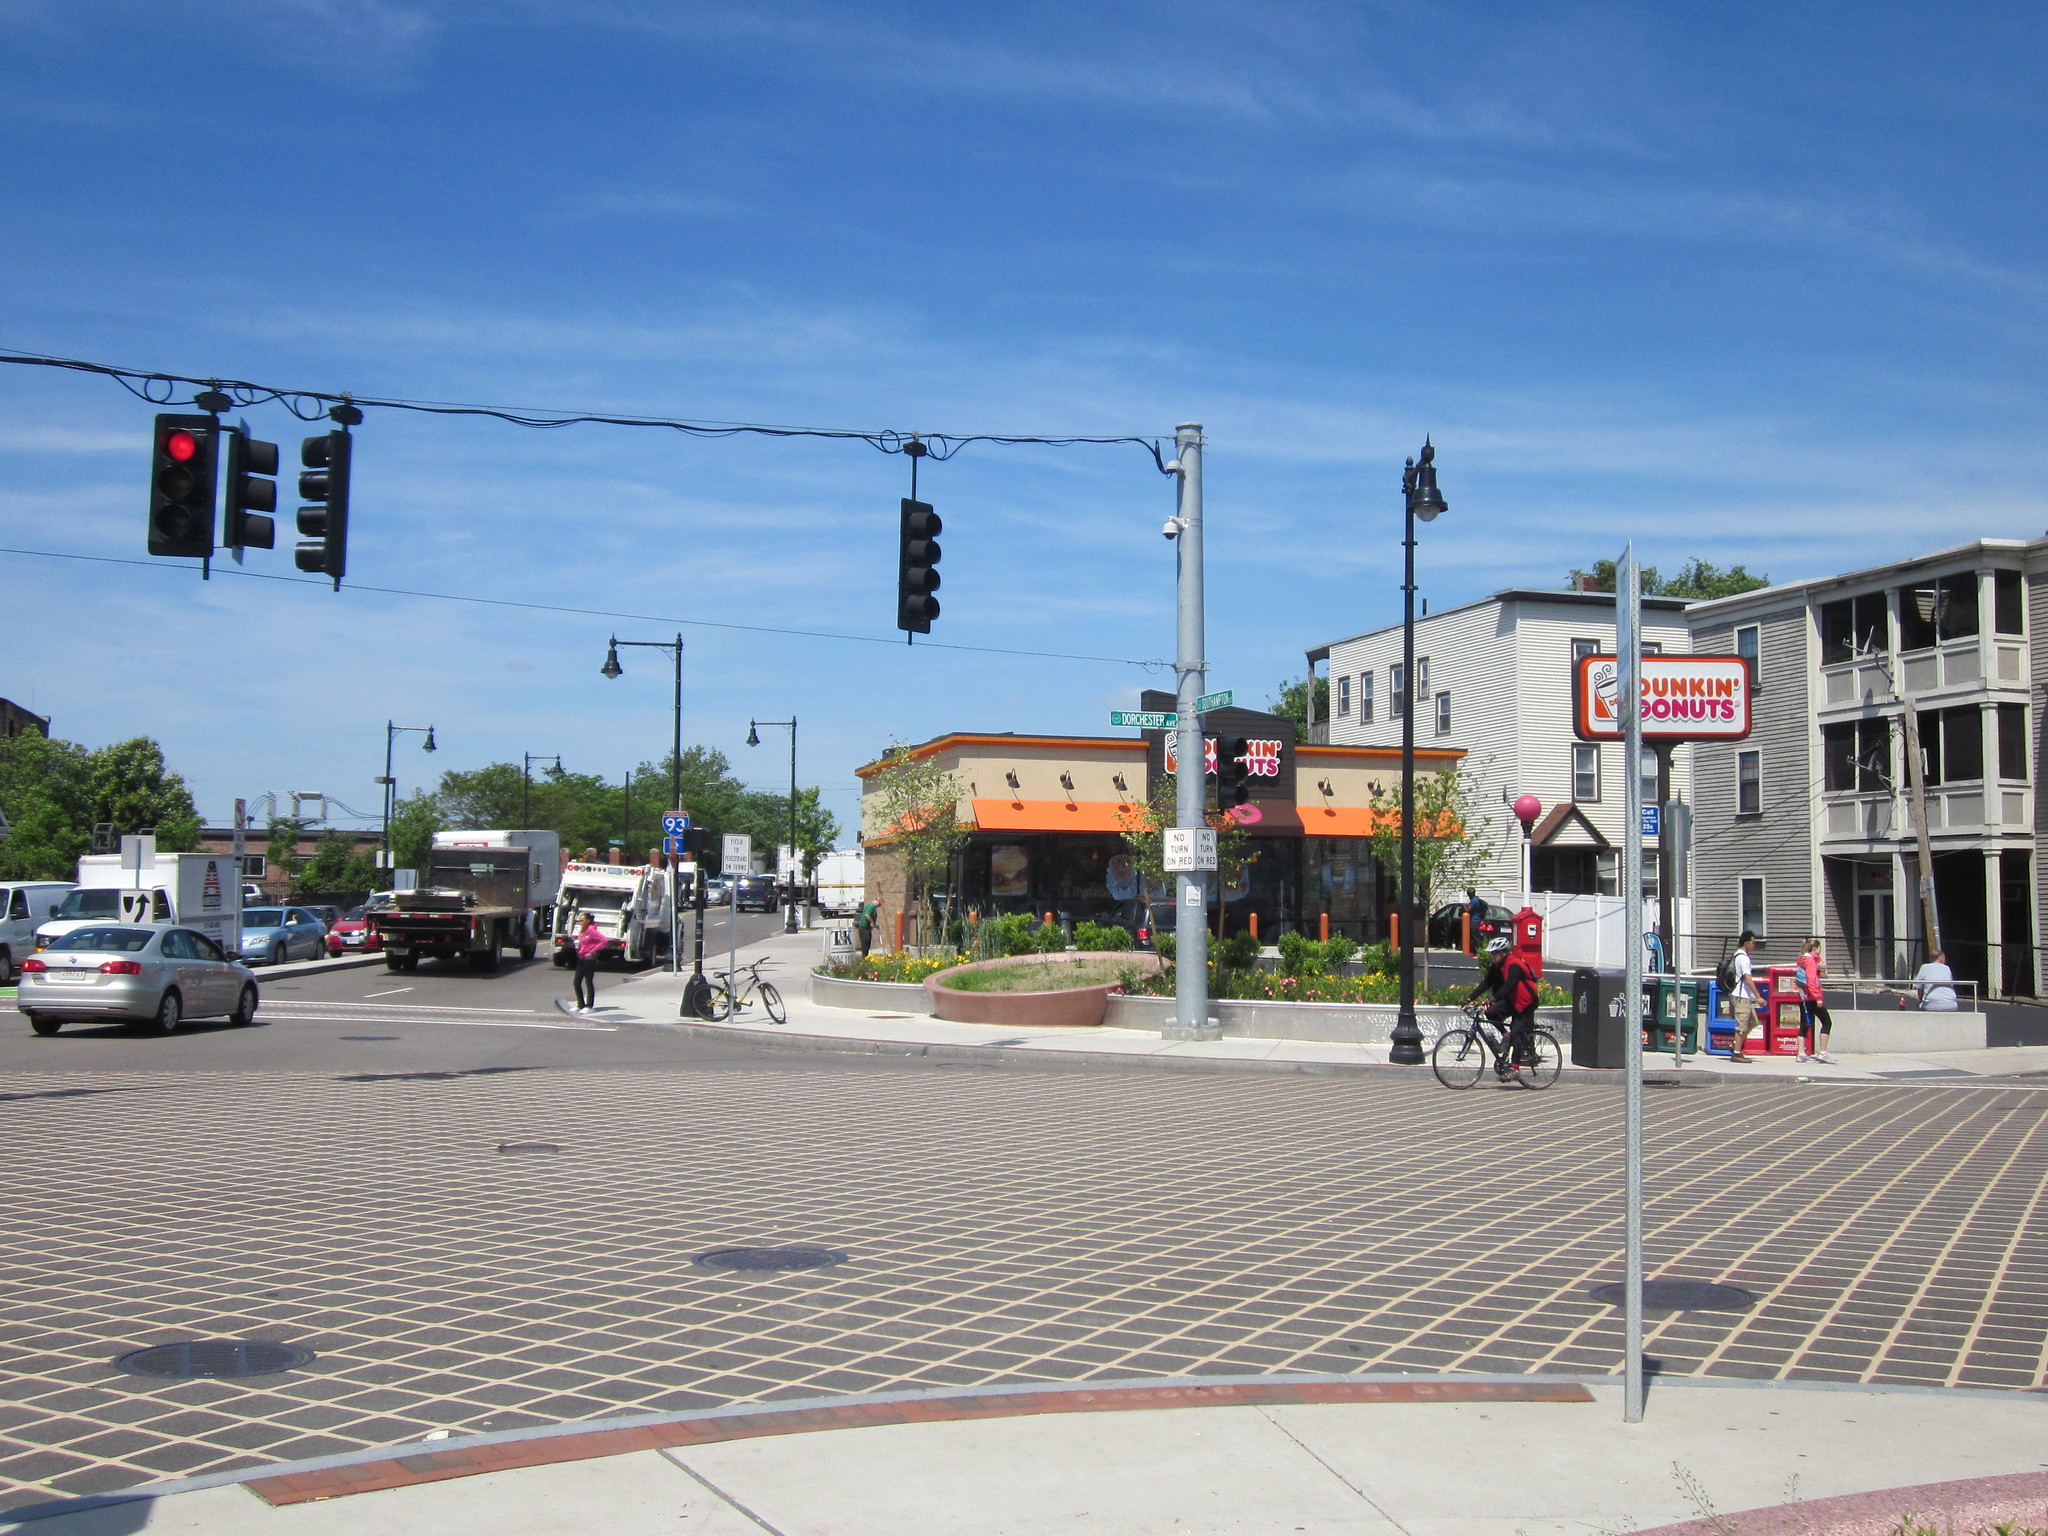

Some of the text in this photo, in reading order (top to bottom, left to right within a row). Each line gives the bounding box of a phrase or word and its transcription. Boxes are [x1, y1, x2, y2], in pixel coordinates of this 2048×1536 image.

[1641, 677, 1740, 697] DUNKIN'
[1641, 699, 1735, 719] DONUTS
[1121, 713, 1165, 726] DORCHESTER
[665, 817, 685, 832] 93
[1174, 834, 1185, 842] NO
[1202, 833, 1211, 841] NO
[1170, 845, 1189, 853] TURN
[1200, 845, 1213, 853] TURN
[1166, 857, 1192, 866] ON RED
[1198, 857, 1216, 865] ON RED
